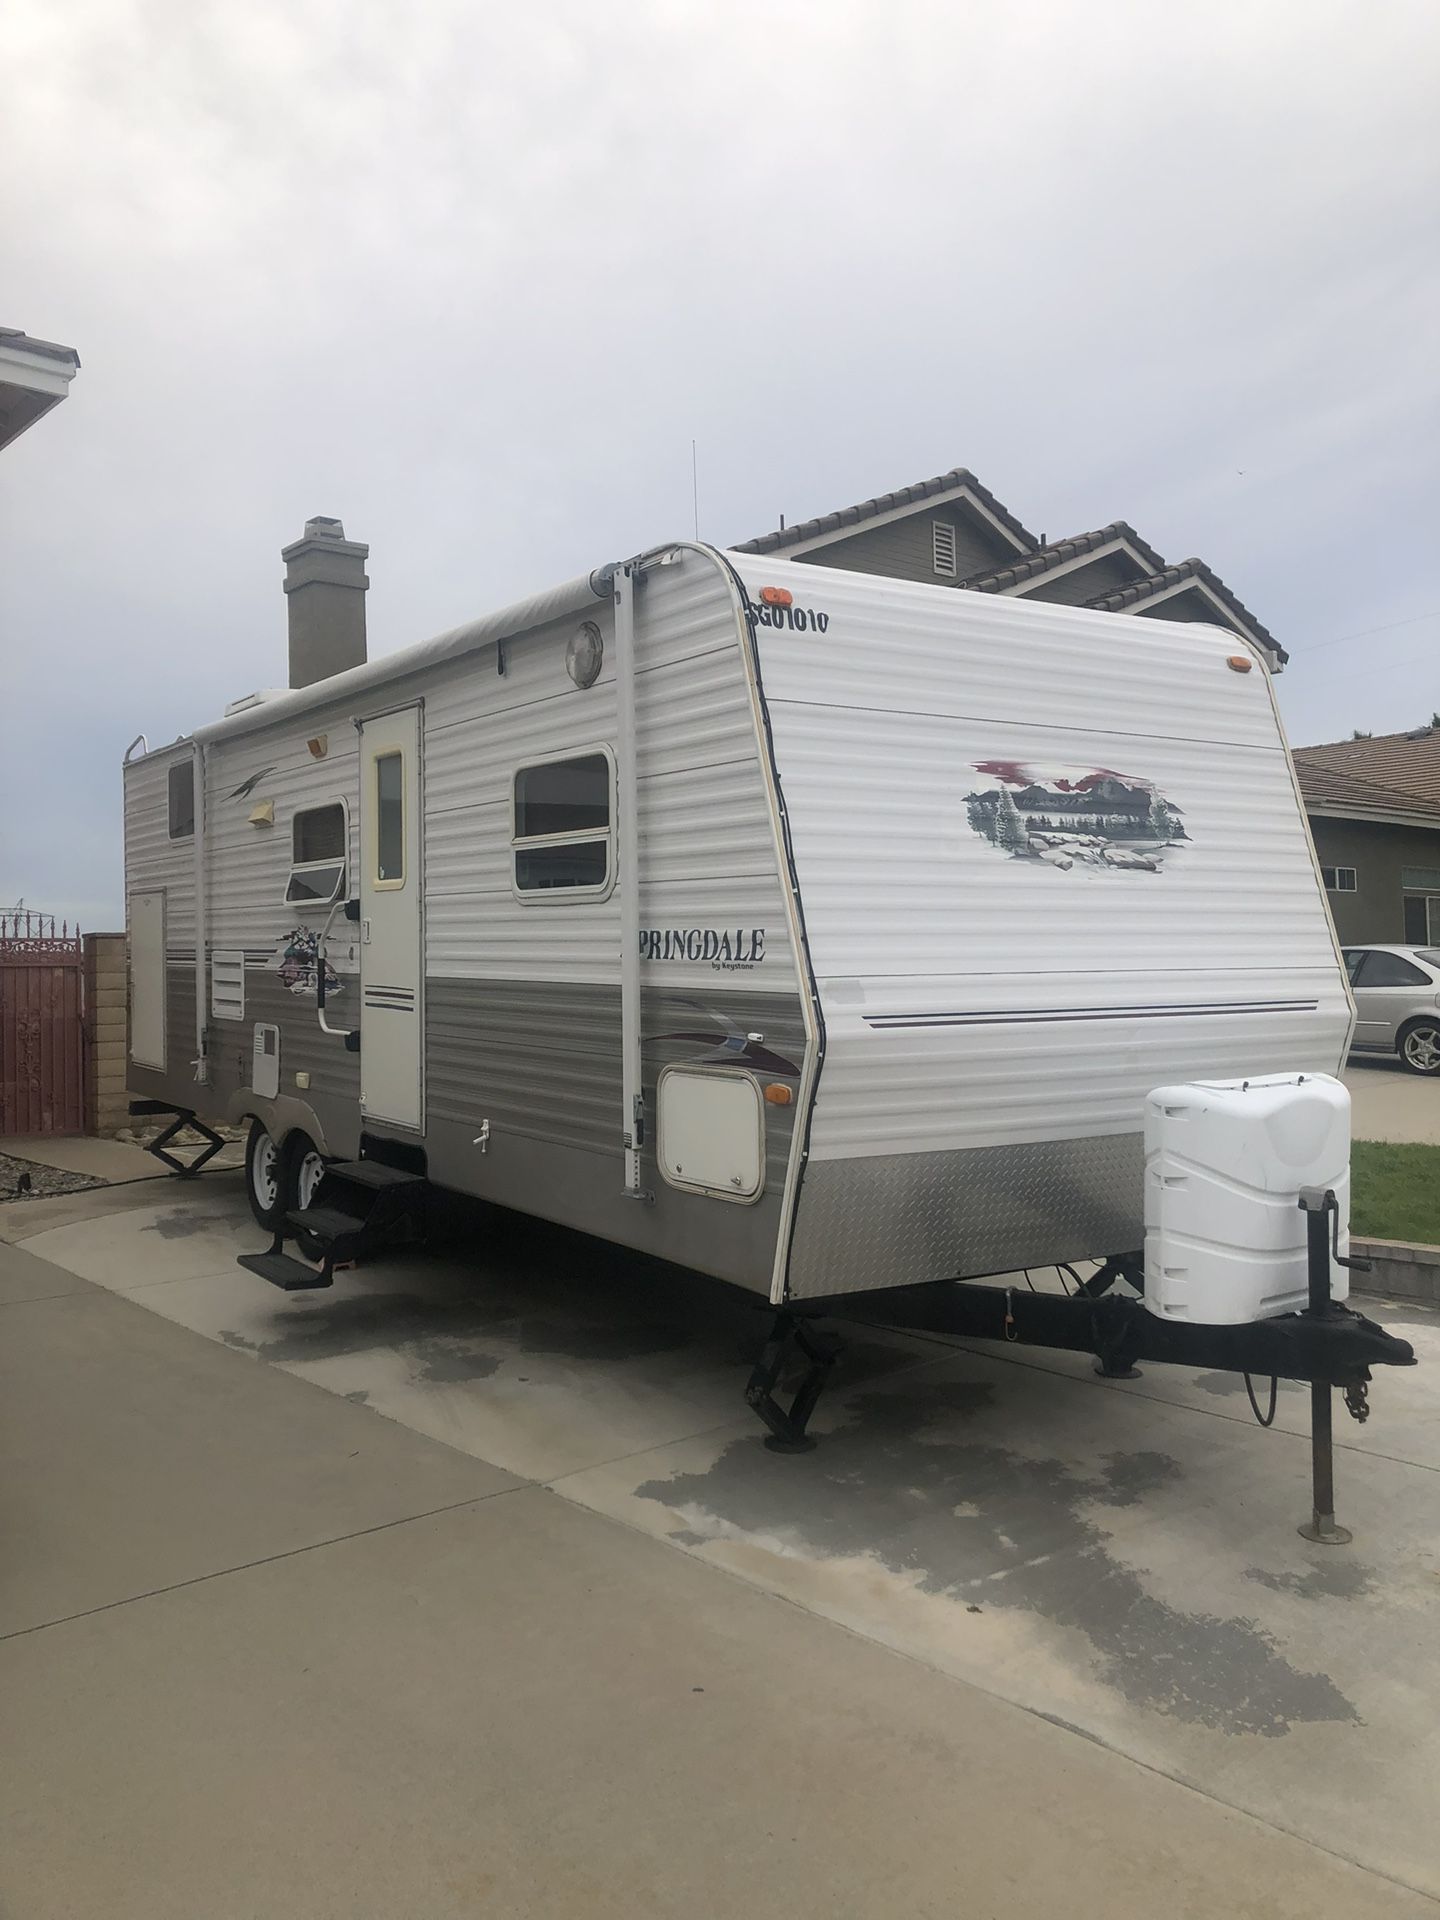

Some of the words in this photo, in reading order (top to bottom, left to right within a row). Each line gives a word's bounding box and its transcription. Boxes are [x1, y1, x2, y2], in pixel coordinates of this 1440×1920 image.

[620, 929, 766, 961] PRINGDALE
[711, 962, 721, 971] by
[722, 961, 754, 971] Keystone
